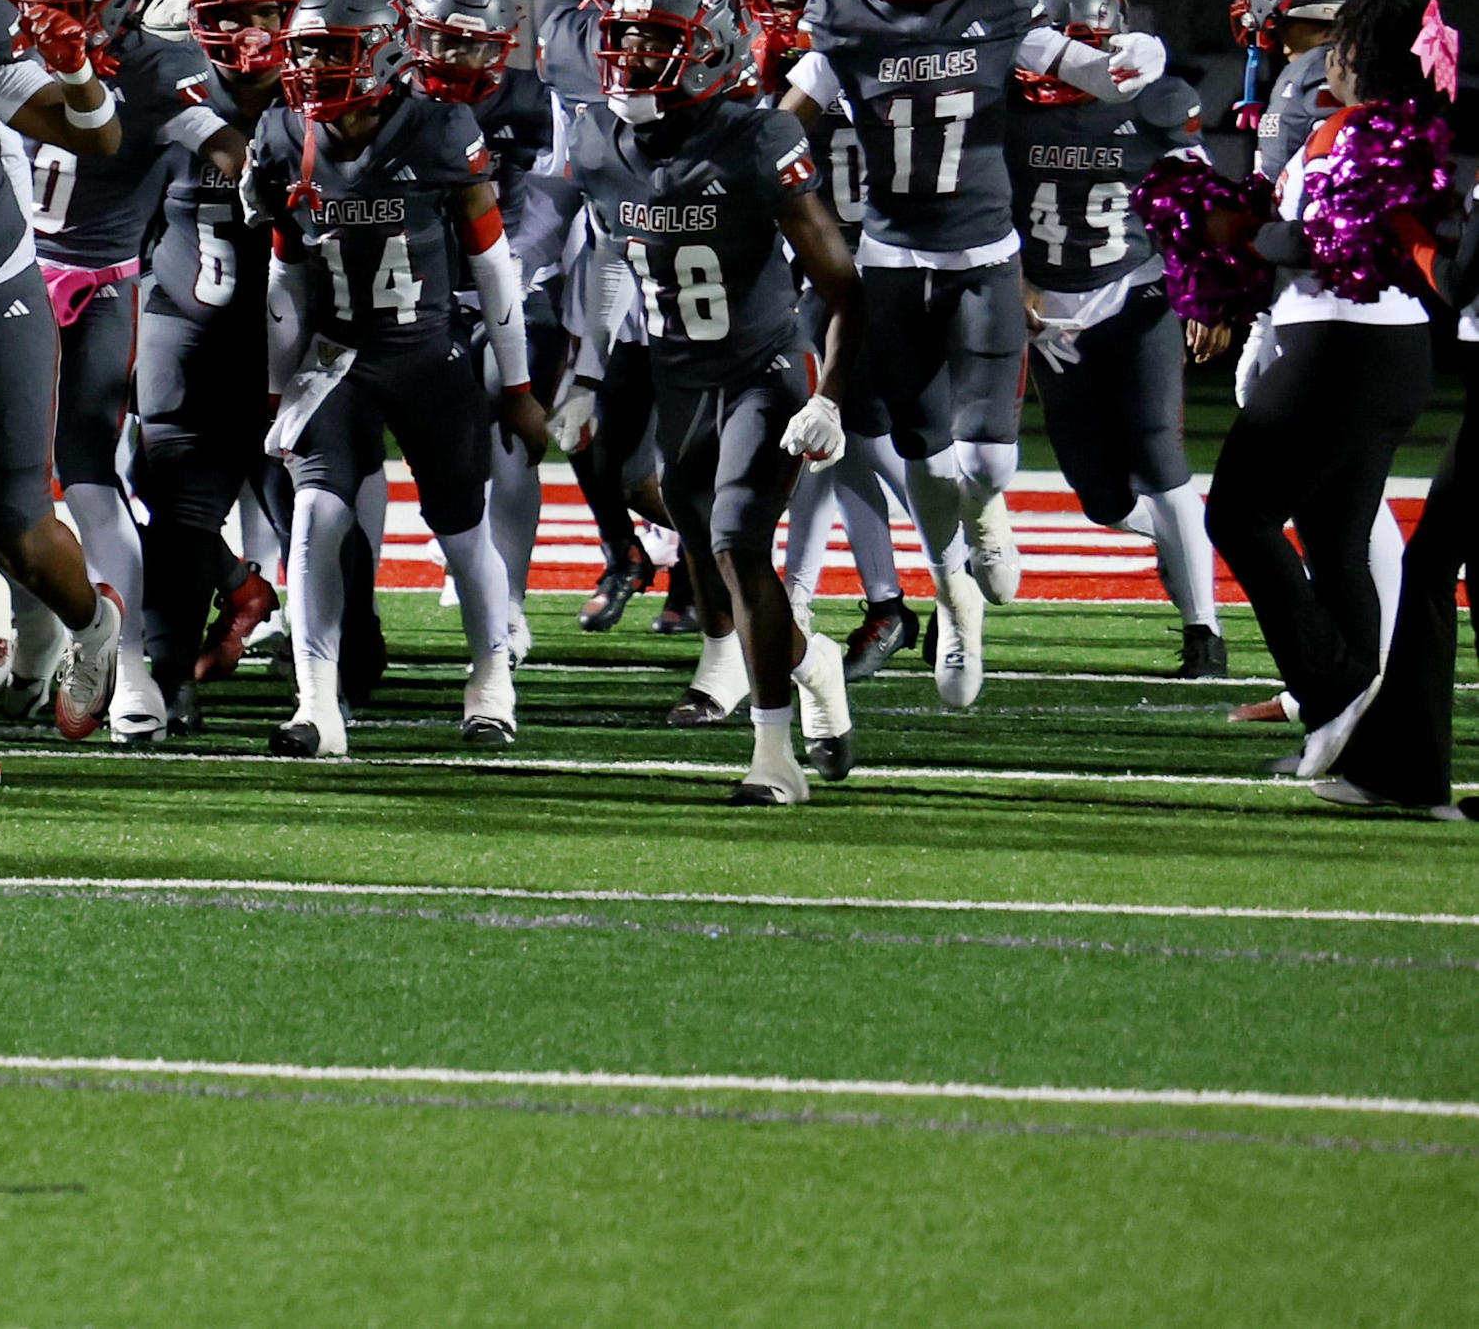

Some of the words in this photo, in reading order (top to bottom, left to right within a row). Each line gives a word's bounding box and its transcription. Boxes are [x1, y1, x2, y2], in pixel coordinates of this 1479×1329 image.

[878, 48, 978, 83] EAGLES
[885, 90, 975, 195] 17
[1029, 146, 1123, 170] EAGLES
[310, 198, 406, 226] EAGLES
[619, 200, 717, 233] EAGLES
[1029, 181, 1132, 268] 49
[321, 234, 423, 326] 14
[625, 236, 731, 342] 18
